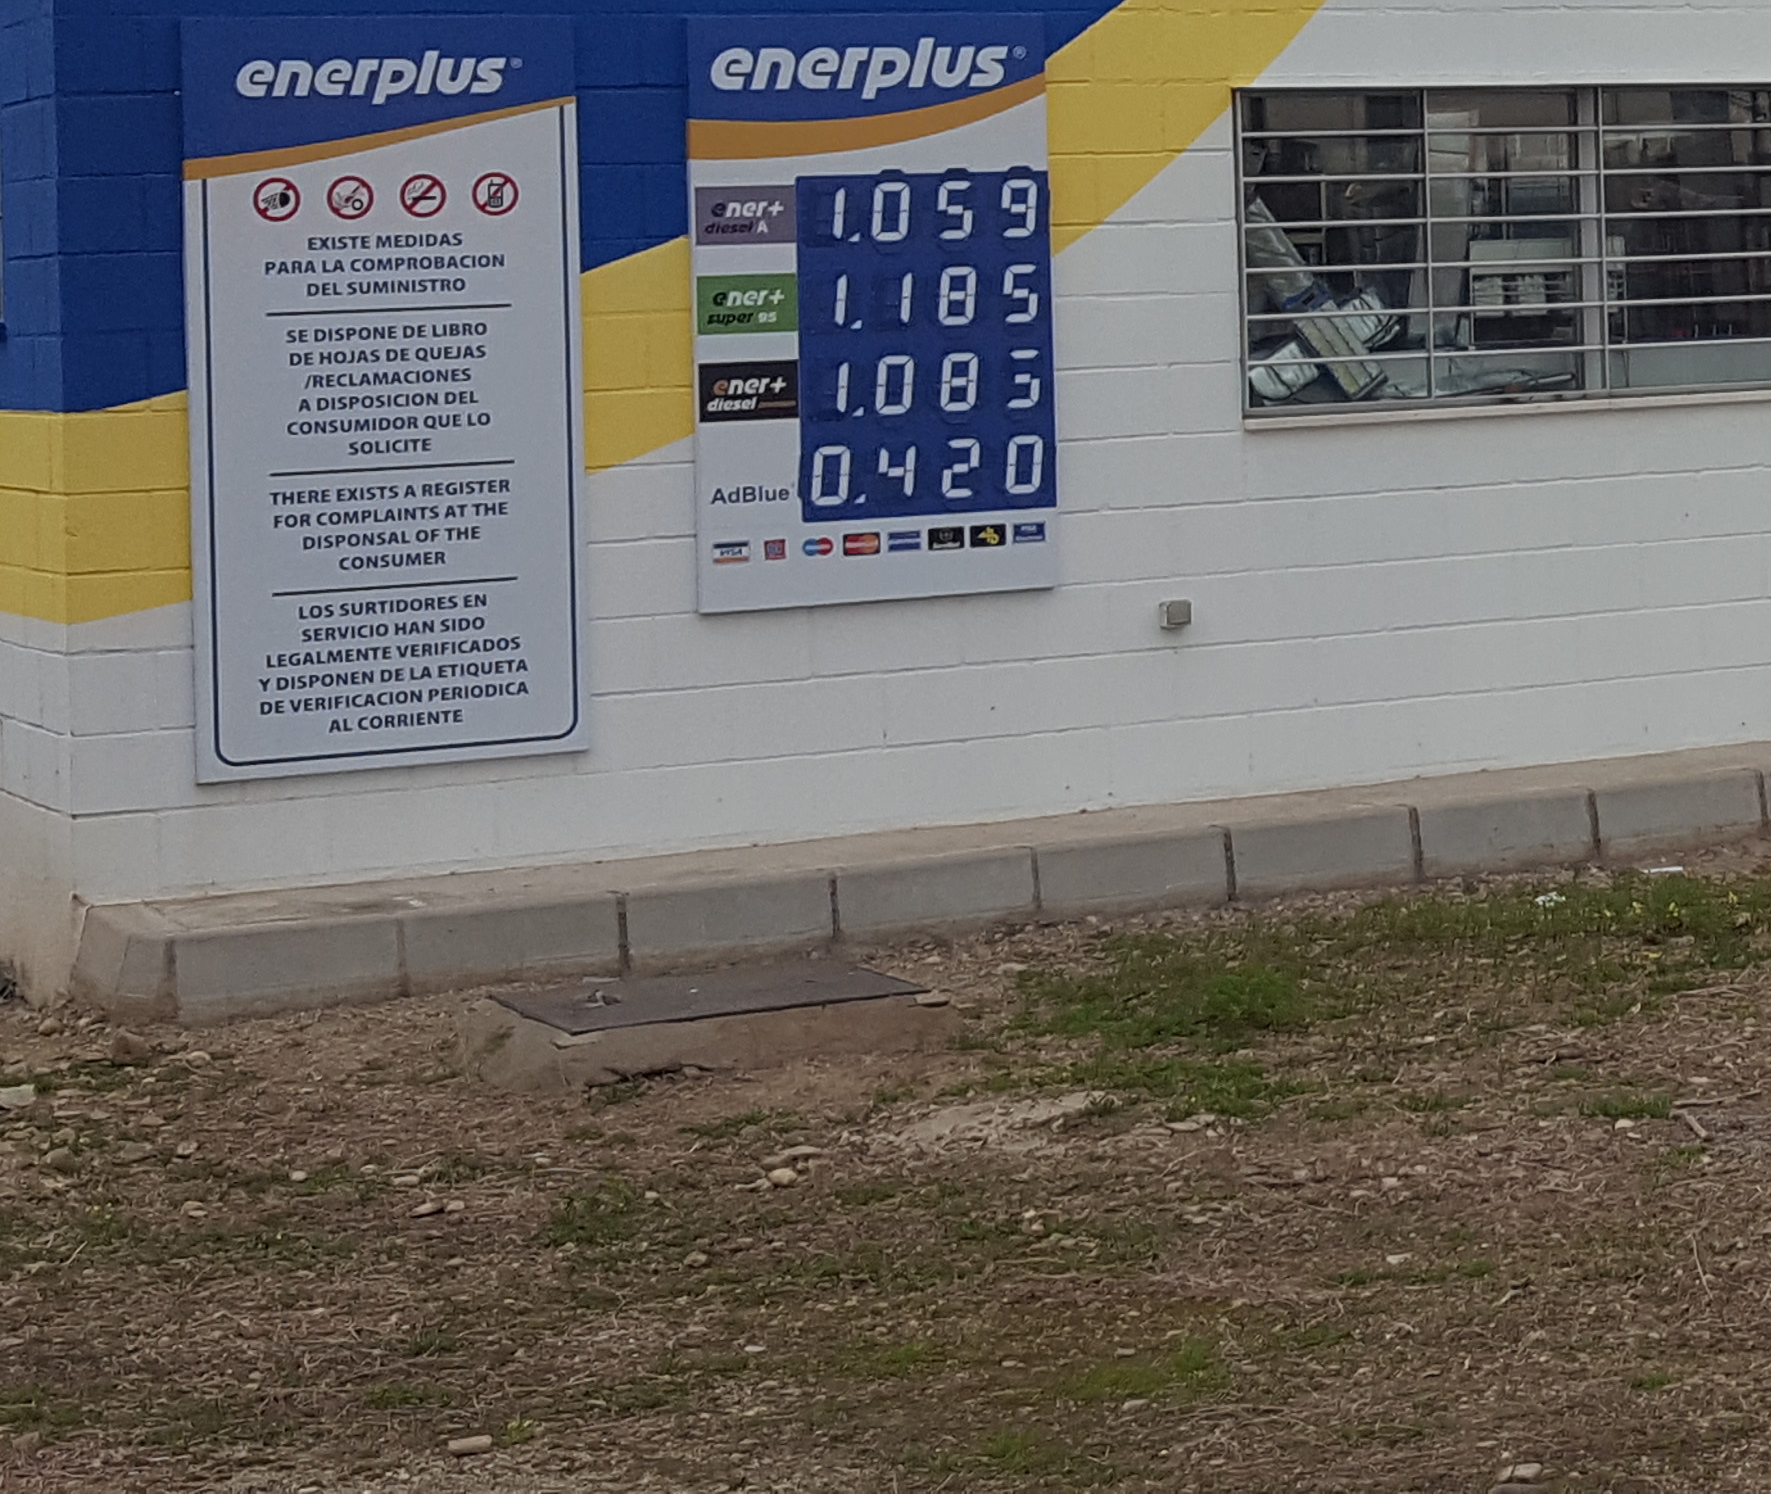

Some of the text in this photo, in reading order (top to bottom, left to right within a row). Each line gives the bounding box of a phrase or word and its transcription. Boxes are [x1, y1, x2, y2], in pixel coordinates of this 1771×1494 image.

[236, 49, 507, 105] enerplus
[710, 37, 1008, 100] enerplus
[711, 201, 784, 218] ener+
[831, 178, 1038, 244] 1.059
[704, 220, 768, 234] diesel A
[307, 232, 463, 251] EXISTE MEDIDAS
[264, 253, 505, 276] PARA LA COMPROBACION
[306, 277, 466, 297] DEL SUMINISTRO
[713, 289, 785, 306] ener+
[834, 264, 1039, 330] 1.185
[707, 312, 753, 326] super
[285, 322, 488, 344] SE DISPONE DE LIBRO
[289, 344, 487, 367] DE HOJAS DE QUEJAS
[304, 367, 472, 390] /RECLAMACIONES
[713, 376, 787, 395] ener+
[298, 390, 480, 413] A DISPOSICION DEL
[707, 396, 757, 411] diesel
[286, 412, 491, 436] CONSUMIDOR QUE LO
[348, 437, 432, 456] SOLICITE
[810, 434, 1044, 506] 0.420
[269, 479, 511, 506] THERE EXISTS A REGISTER
[710, 485, 790, 505] AdBlue
[273, 501, 508, 529] FOR COMPLAINTS AT THE
[302, 525, 481, 551] DISPONSAL OF THE
[338, 551, 446, 571] CONSUMER
[298, 593, 487, 620] LOS SURTIDORES EN
[301, 616, 485, 643] SERVICIO HAN SIDO
[266, 636, 521, 669] LEGALMENTE VERIFICADOS
[258, 658, 529, 693] Y DISPONEN DE LA ETIQUETA
[259, 681, 530, 716] DE VERIFICACION PERIODICA
[328, 709, 463, 734] AL CORRIENTE
